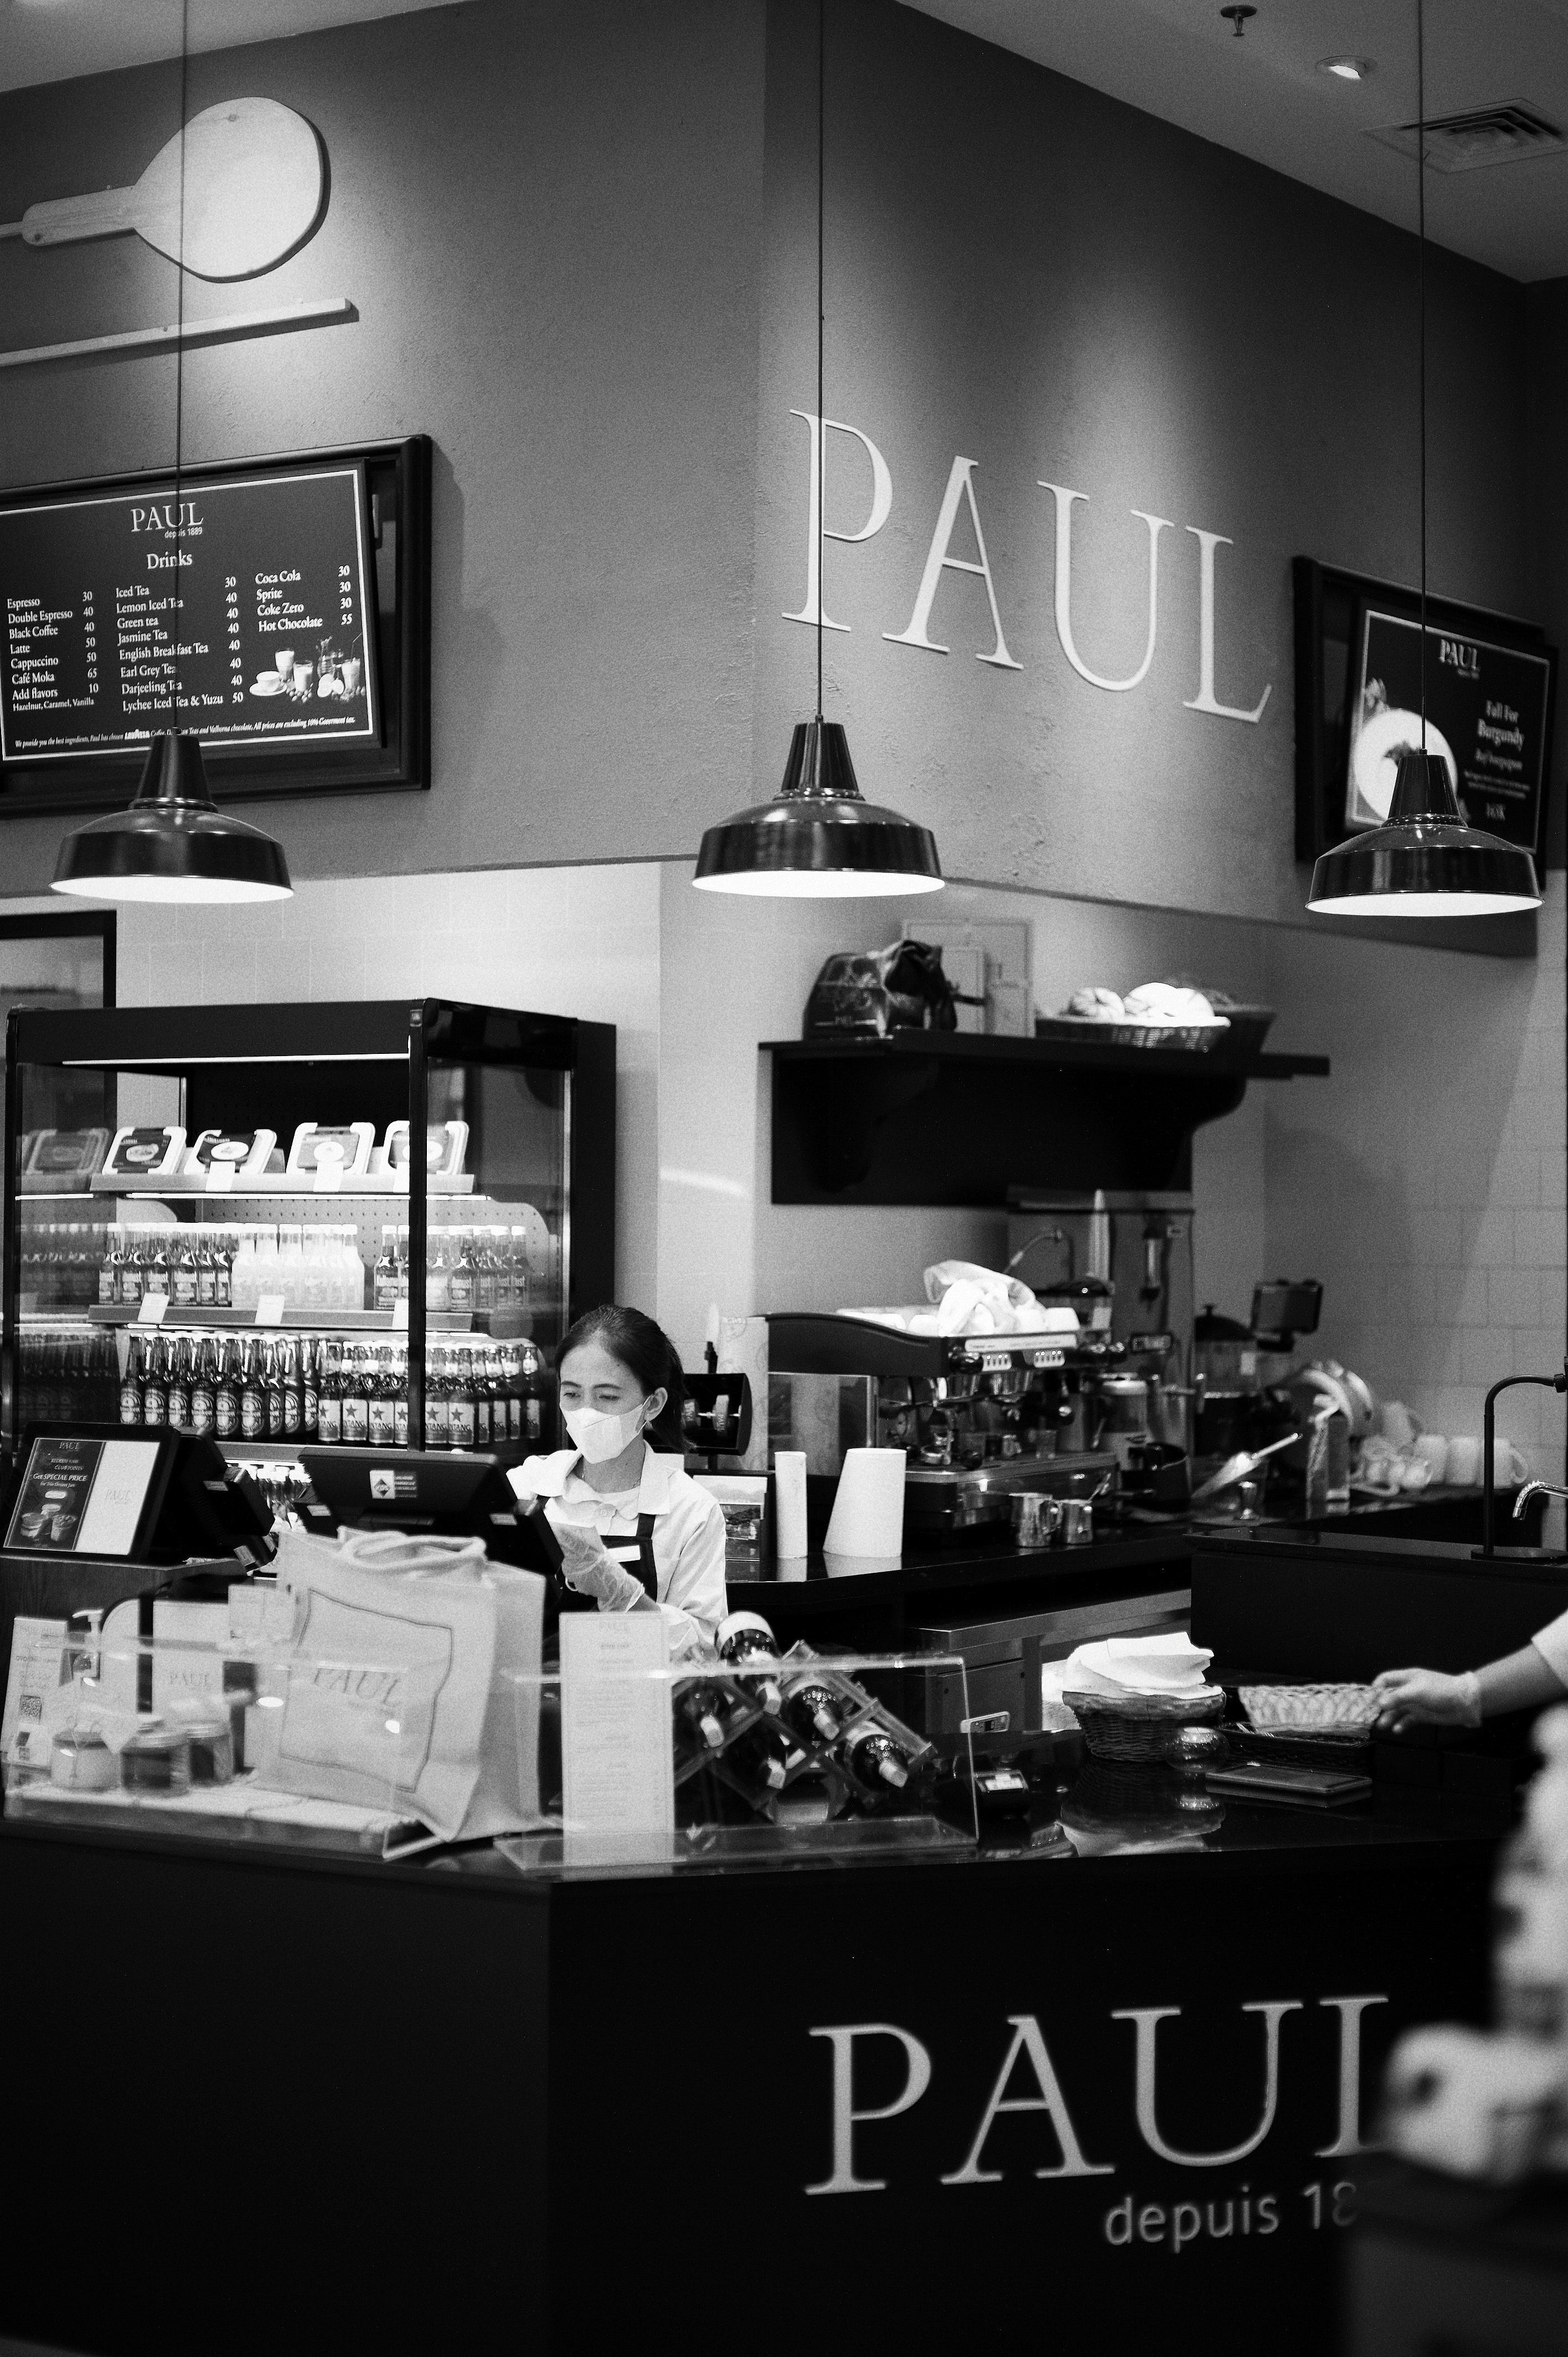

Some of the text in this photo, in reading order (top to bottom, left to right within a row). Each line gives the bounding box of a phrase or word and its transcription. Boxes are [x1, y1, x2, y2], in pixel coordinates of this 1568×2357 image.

[130, 502, 204, 532] PAUL
[146, 549, 193, 569] Drinks
[781, 408, 1272, 723] PAUL
[255, 569, 301, 585] Coca Cola
[338, 565, 350, 577] 30
[224, 576, 236, 588] 30
[339, 581, 351, 593] 30
[82, 590, 92, 602] 30
[116, 585, 150, 598] Iced Tea
[225, 591, 238, 604] 40
[256, 587, 283, 603] Sprite
[7, 598, 40, 611] Espresso
[116, 597, 184, 614] Lemon Iced Tea
[257, 602, 305, 616] Coke Zero
[340, 597, 352, 609] 30
[8, 610, 73, 624] Double Espresso
[83, 606, 94, 617] 40
[226, 607, 239, 619] 40
[117, 616, 159, 629] Green tea
[258, 615, 323, 632] Hot Chocolate
[341, 613, 353, 625] 55
[9, 624, 59, 639] Black Coffee
[84, 621, 95, 632] 40
[227, 622, 239, 634] 40
[85, 637, 96, 648] 50
[117, 629, 168, 646] Jasmine Tea
[10, 644, 30, 655] Latte
[228, 639, 240, 651] 40
[86, 651, 97, 663] 50
[119, 642, 209, 662] English Breakfast Tea
[1440, 639, 1479, 670] PAUL
[11, 655, 59, 671] Cappuccino
[230, 657, 241, 669] 40
[12, 671, 55, 685] Café Moka
[87, 667, 97, 678] 65
[120, 666, 137, 678] Earl
[139, 665, 160, 678] Grey
[230, 674, 243, 686] 40
[12, 687, 58, 701] Add flavors
[89, 683, 99, 693] 10
[121, 680, 167, 696] Darjeeling
[73, 697, 95, 707] Vanilla
[123, 698, 152, 714] Lychee
[154, 696, 172, 709] Iced
[190, 695, 200, 707] &
[201, 693, 223, 706] Yuzu
[231, 691, 244, 704] 50
[1105, 2180, 1356, 2253] depuis 18
